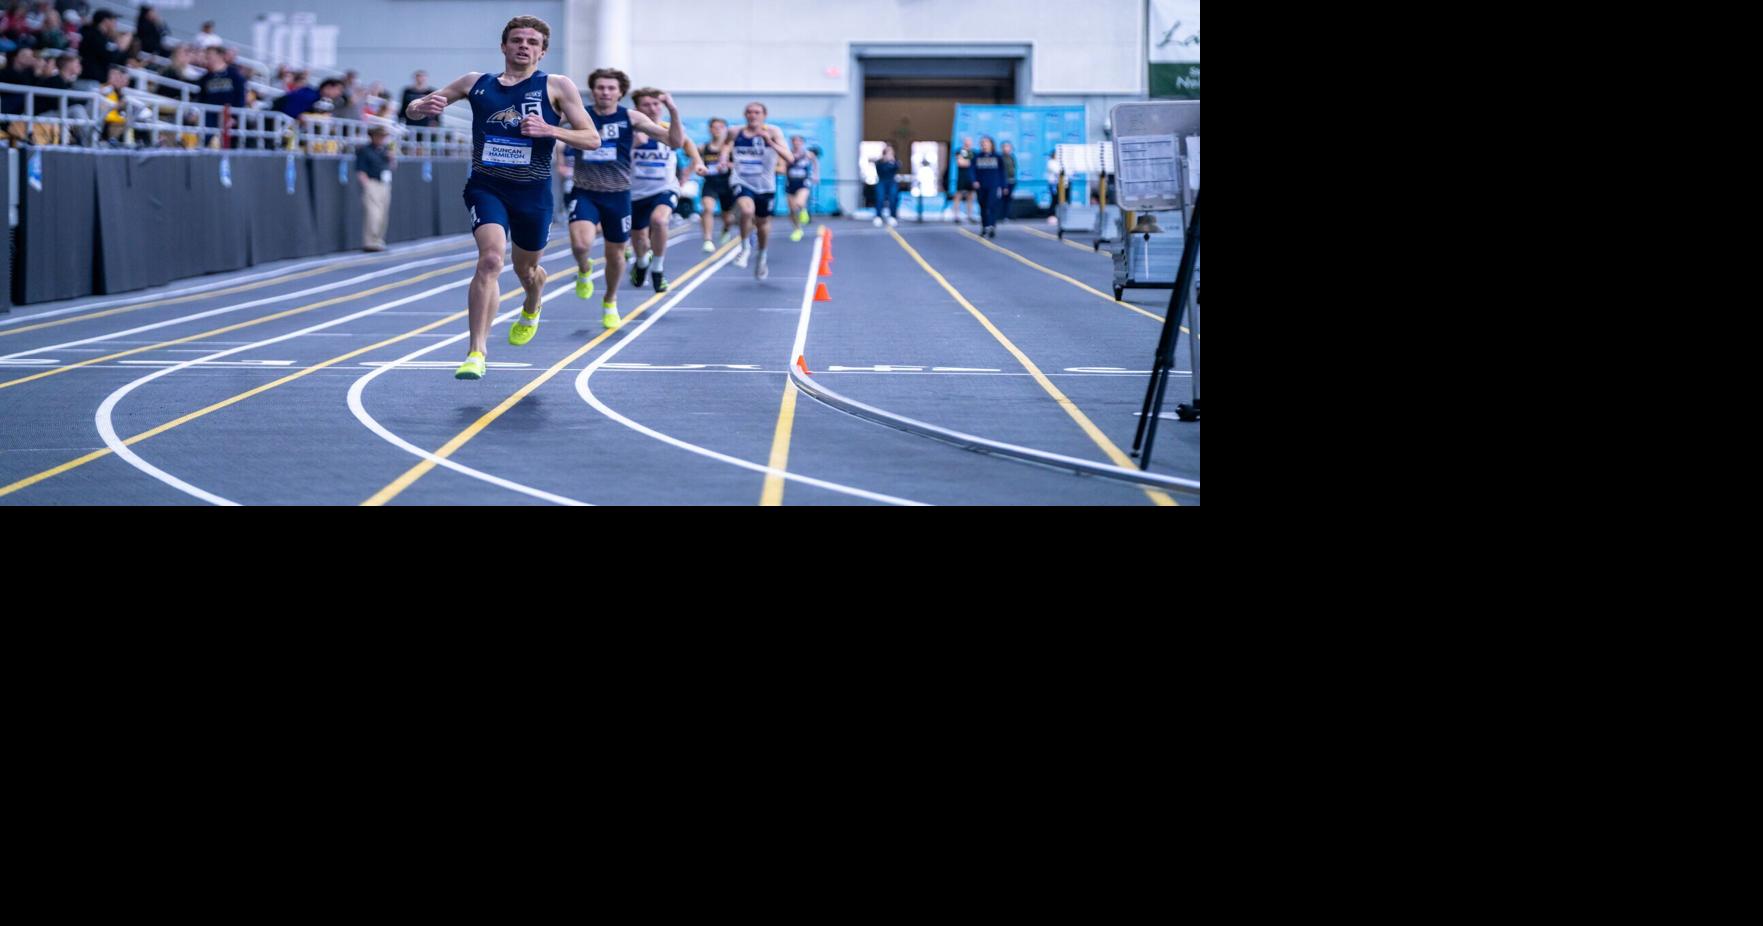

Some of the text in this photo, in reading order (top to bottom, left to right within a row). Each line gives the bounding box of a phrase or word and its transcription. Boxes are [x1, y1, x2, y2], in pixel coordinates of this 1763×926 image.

[524, 103, 539, 116] 5
[607, 124, 616, 137] 8
[492, 146, 522, 154] DUNCAN
[633, 151, 670, 160] NAU
